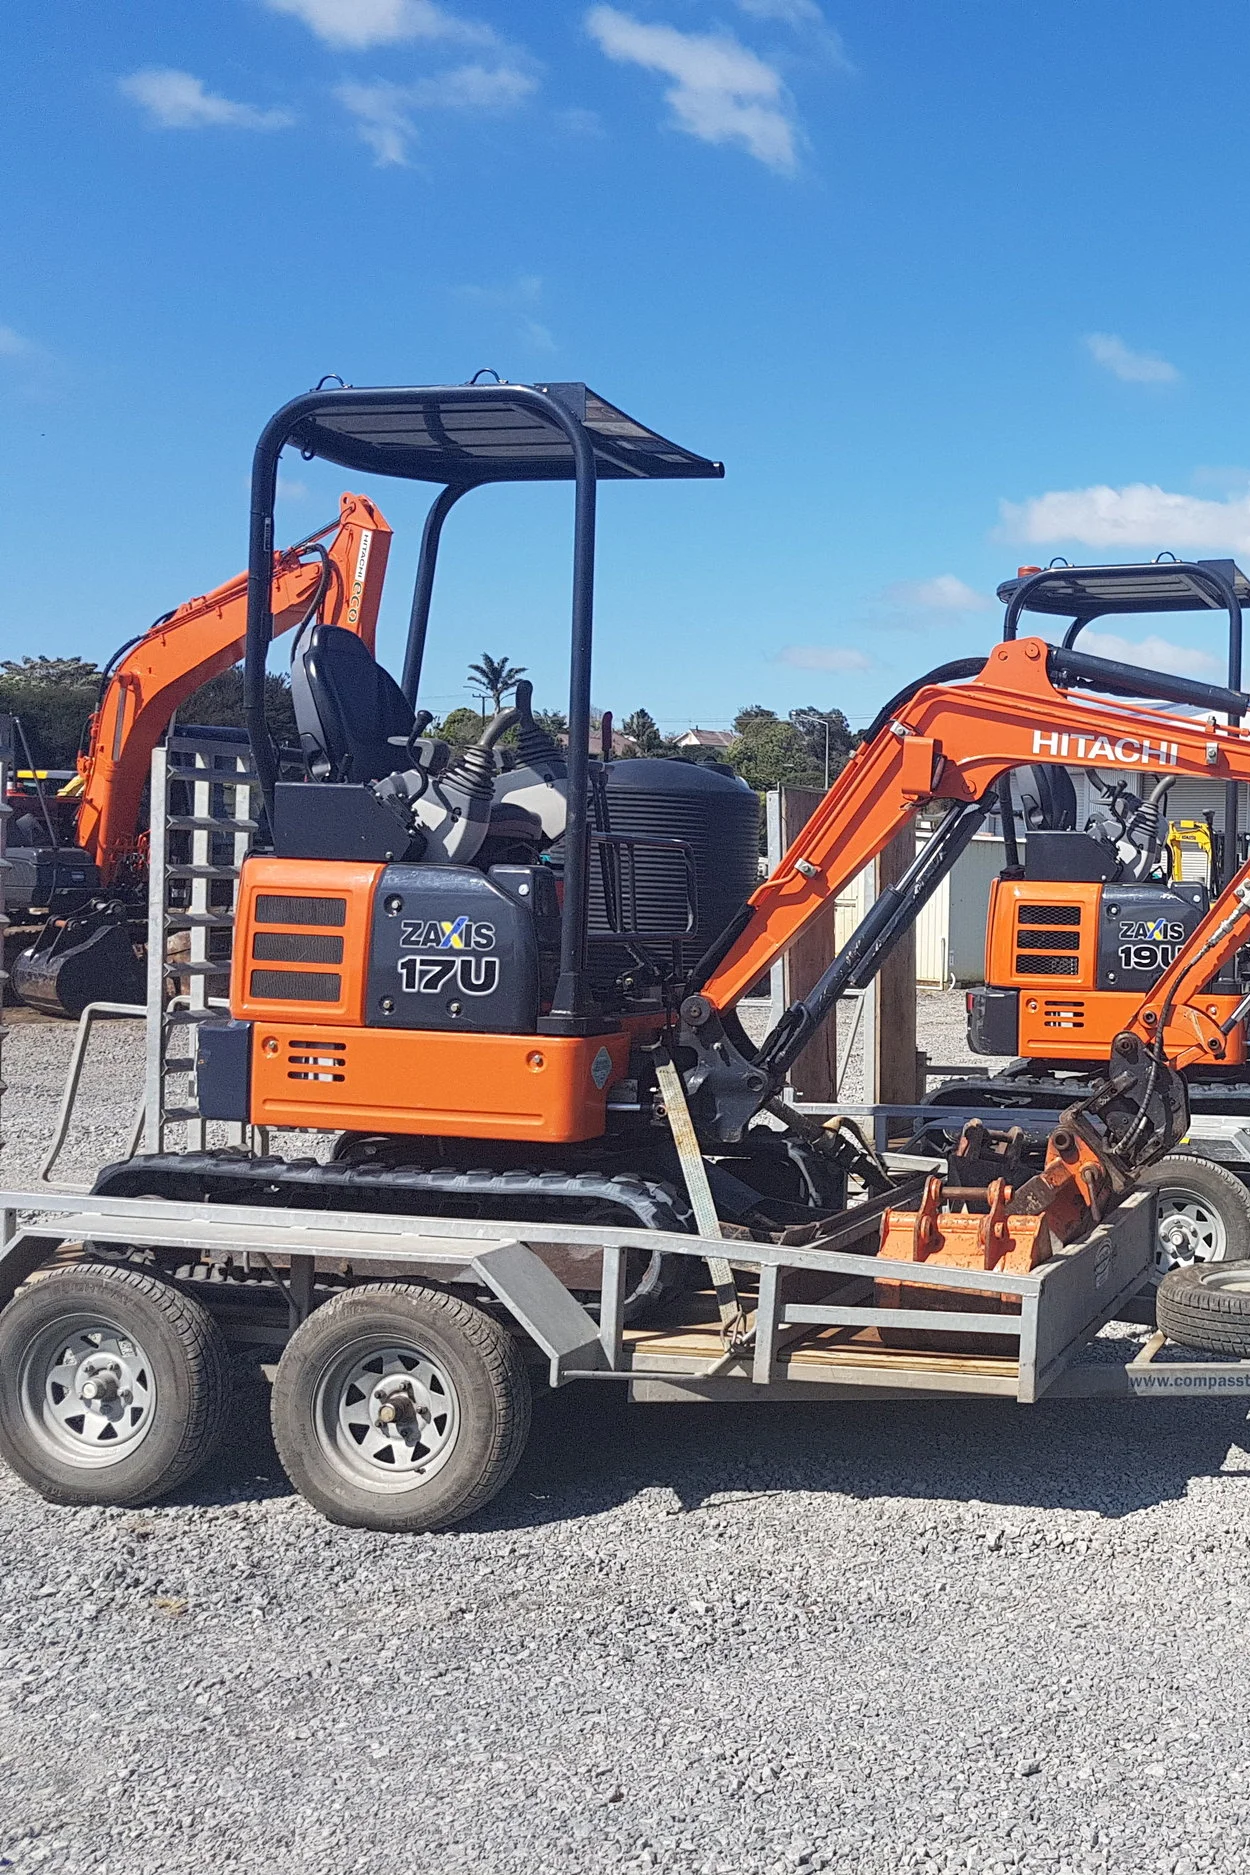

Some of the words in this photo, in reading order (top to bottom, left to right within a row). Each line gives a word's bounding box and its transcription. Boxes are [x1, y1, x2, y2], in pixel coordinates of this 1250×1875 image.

[358, 533, 369, 579] HITACHI
[1032, 729, 1179, 766] HITACHI
[400, 916, 496, 951] ZAXIS
[1119, 918, 1185, 941] ZAXIS
[398, 955, 499, 996] 17U
